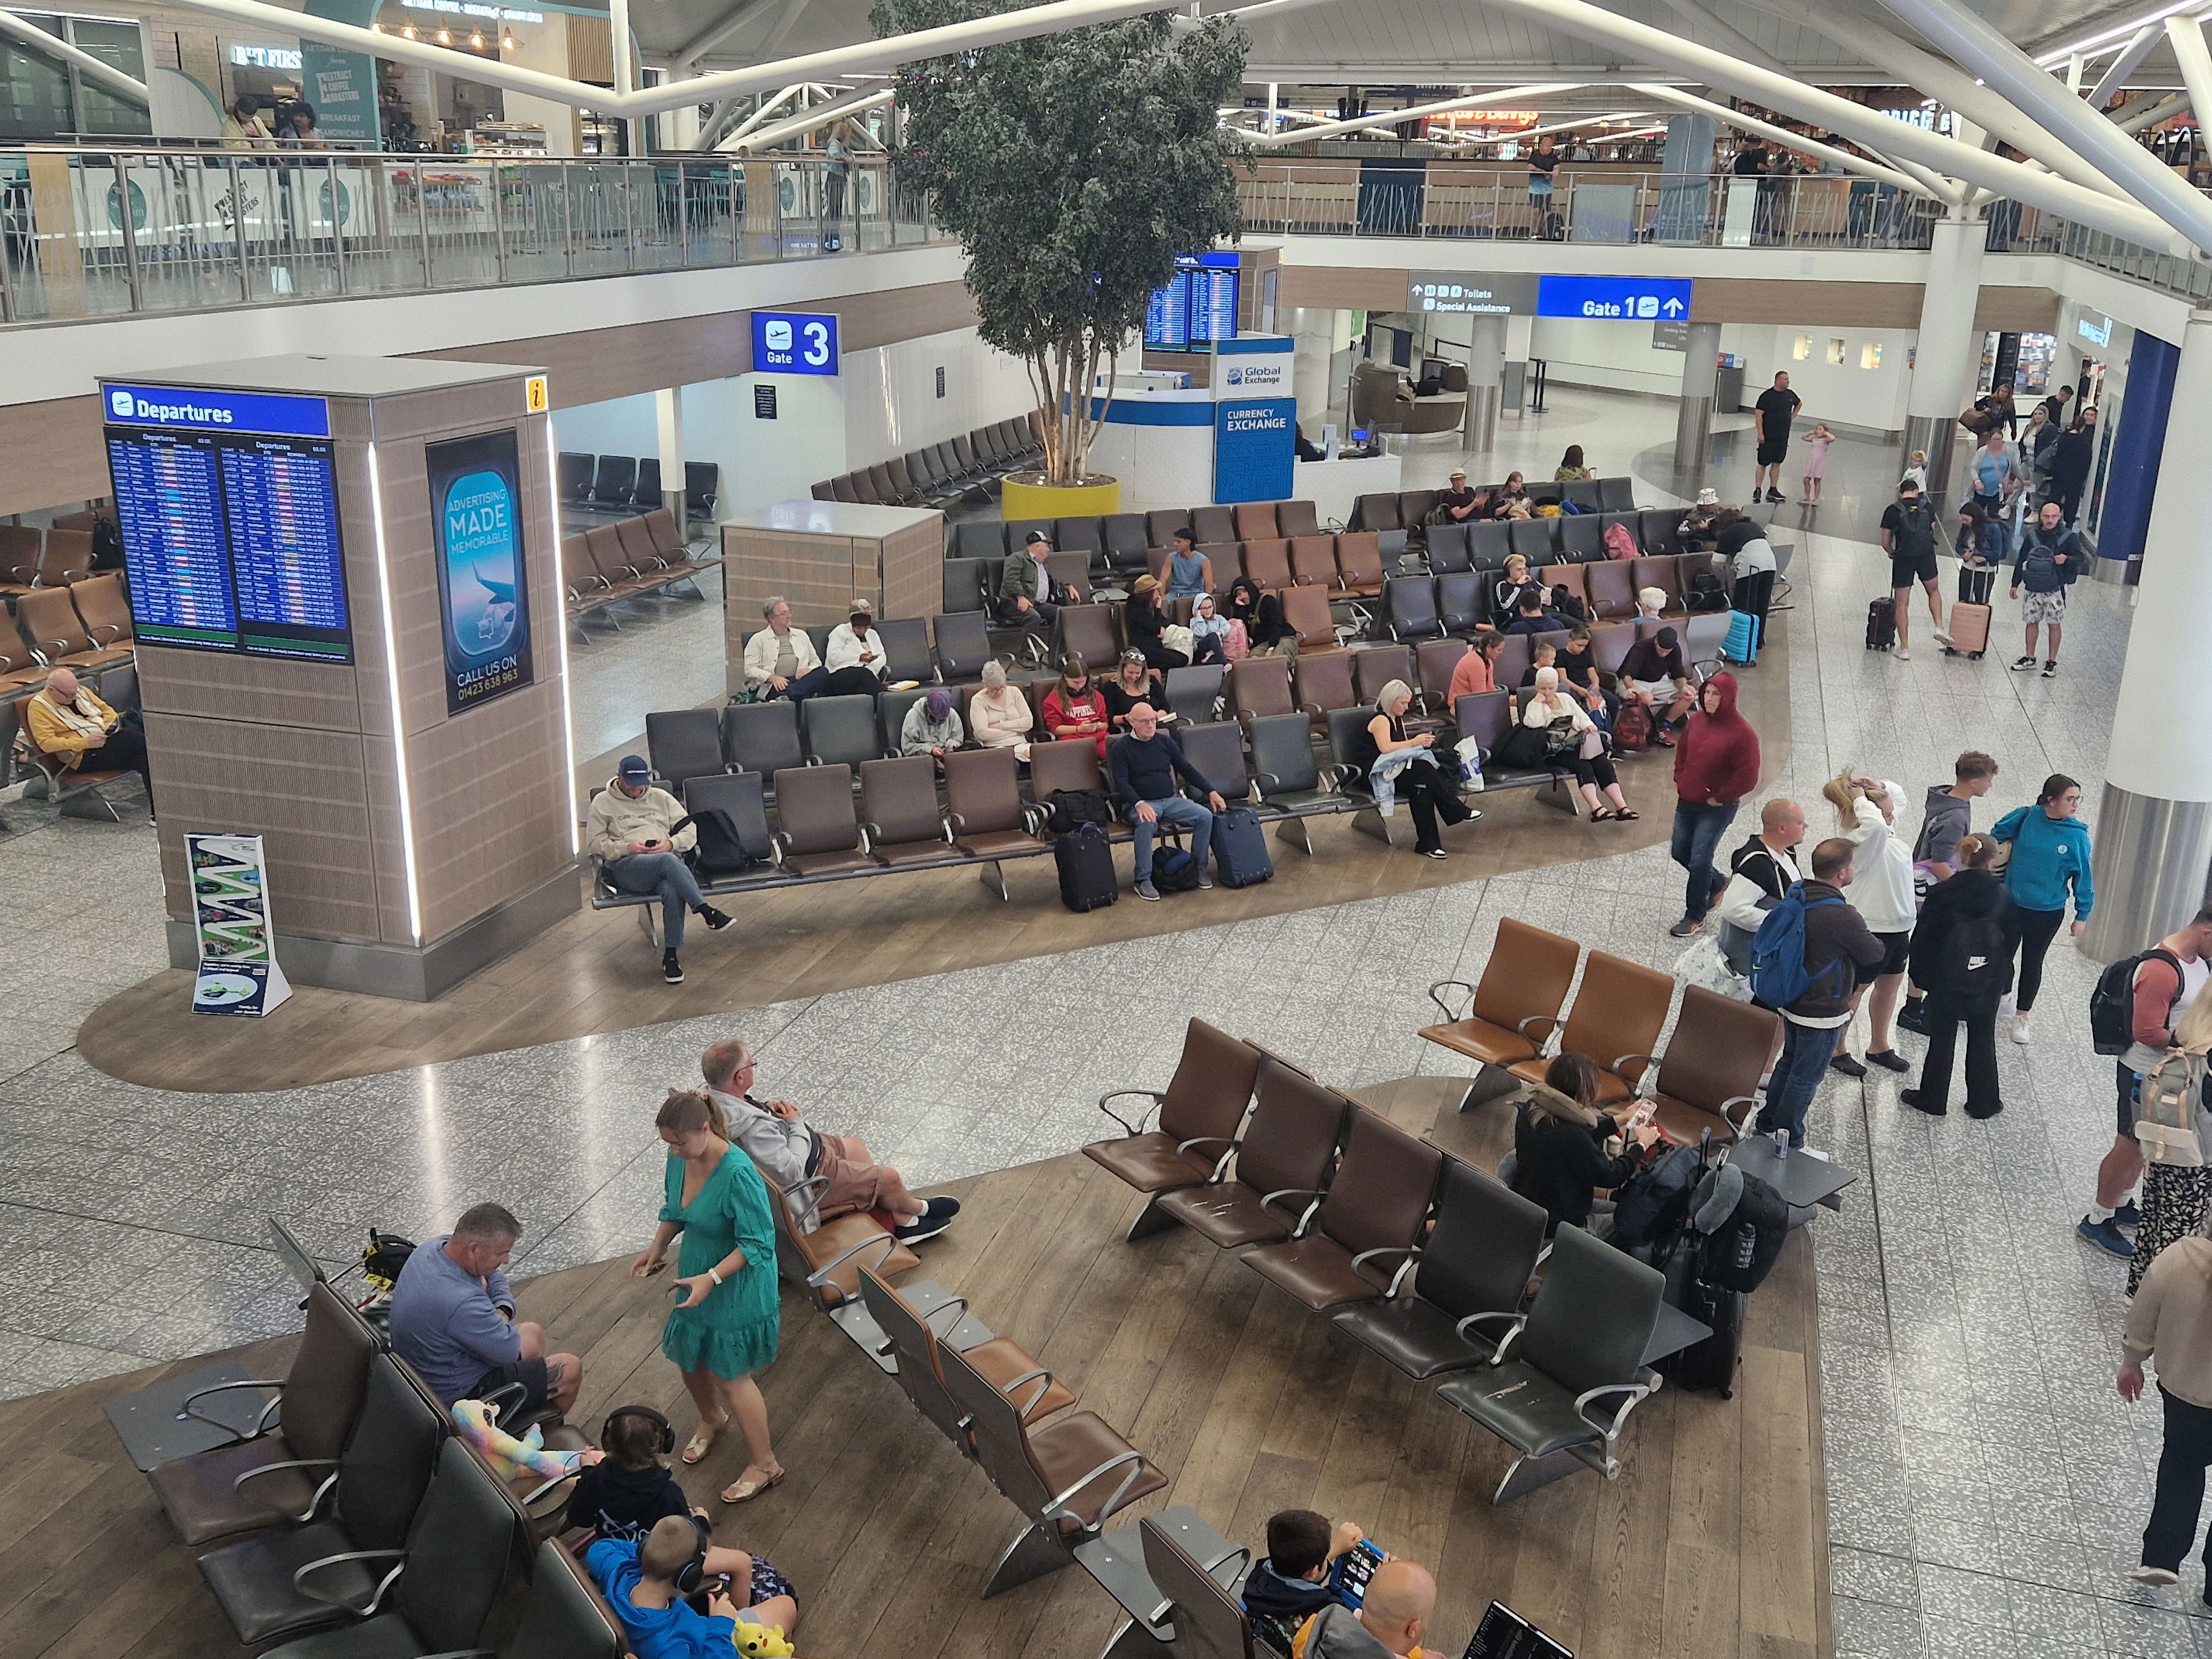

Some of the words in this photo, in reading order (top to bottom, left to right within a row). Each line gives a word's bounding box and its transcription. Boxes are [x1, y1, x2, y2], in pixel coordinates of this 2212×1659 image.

[266, 49, 303, 69] FIRS
[320, 114, 360, 122] BREAKFAST
[1463, 289, 1492, 298] Toilets
[1436, 301, 1465, 312] Special
[1466, 302, 1511, 313] Assistance
[1583, 300, 1621, 316] Gate
[1625, 296, 1635, 317] 1
[803, 322, 830, 366] 3
[767, 351, 793, 364] Gate
[1245, 366, 1280, 377] Global
[1245, 377, 1280, 385] Exchange
[136, 398, 234, 424] Departures
[1227, 408, 1275, 419] CURRENCY
[1227, 417, 1286, 432] EXCHANGE
[448, 489, 506, 513] ADVERTISING
[449, 503, 507, 541] MADE
[451, 529, 509, 556] MEMORABLE
[457, 667, 485, 687] CALL
[485, 660, 500, 677] US
[502, 654, 517, 670] ON
[458, 682, 484, 701] 01423
[484, 676, 501, 691] 638
[502, 668, 518, 684] 963
